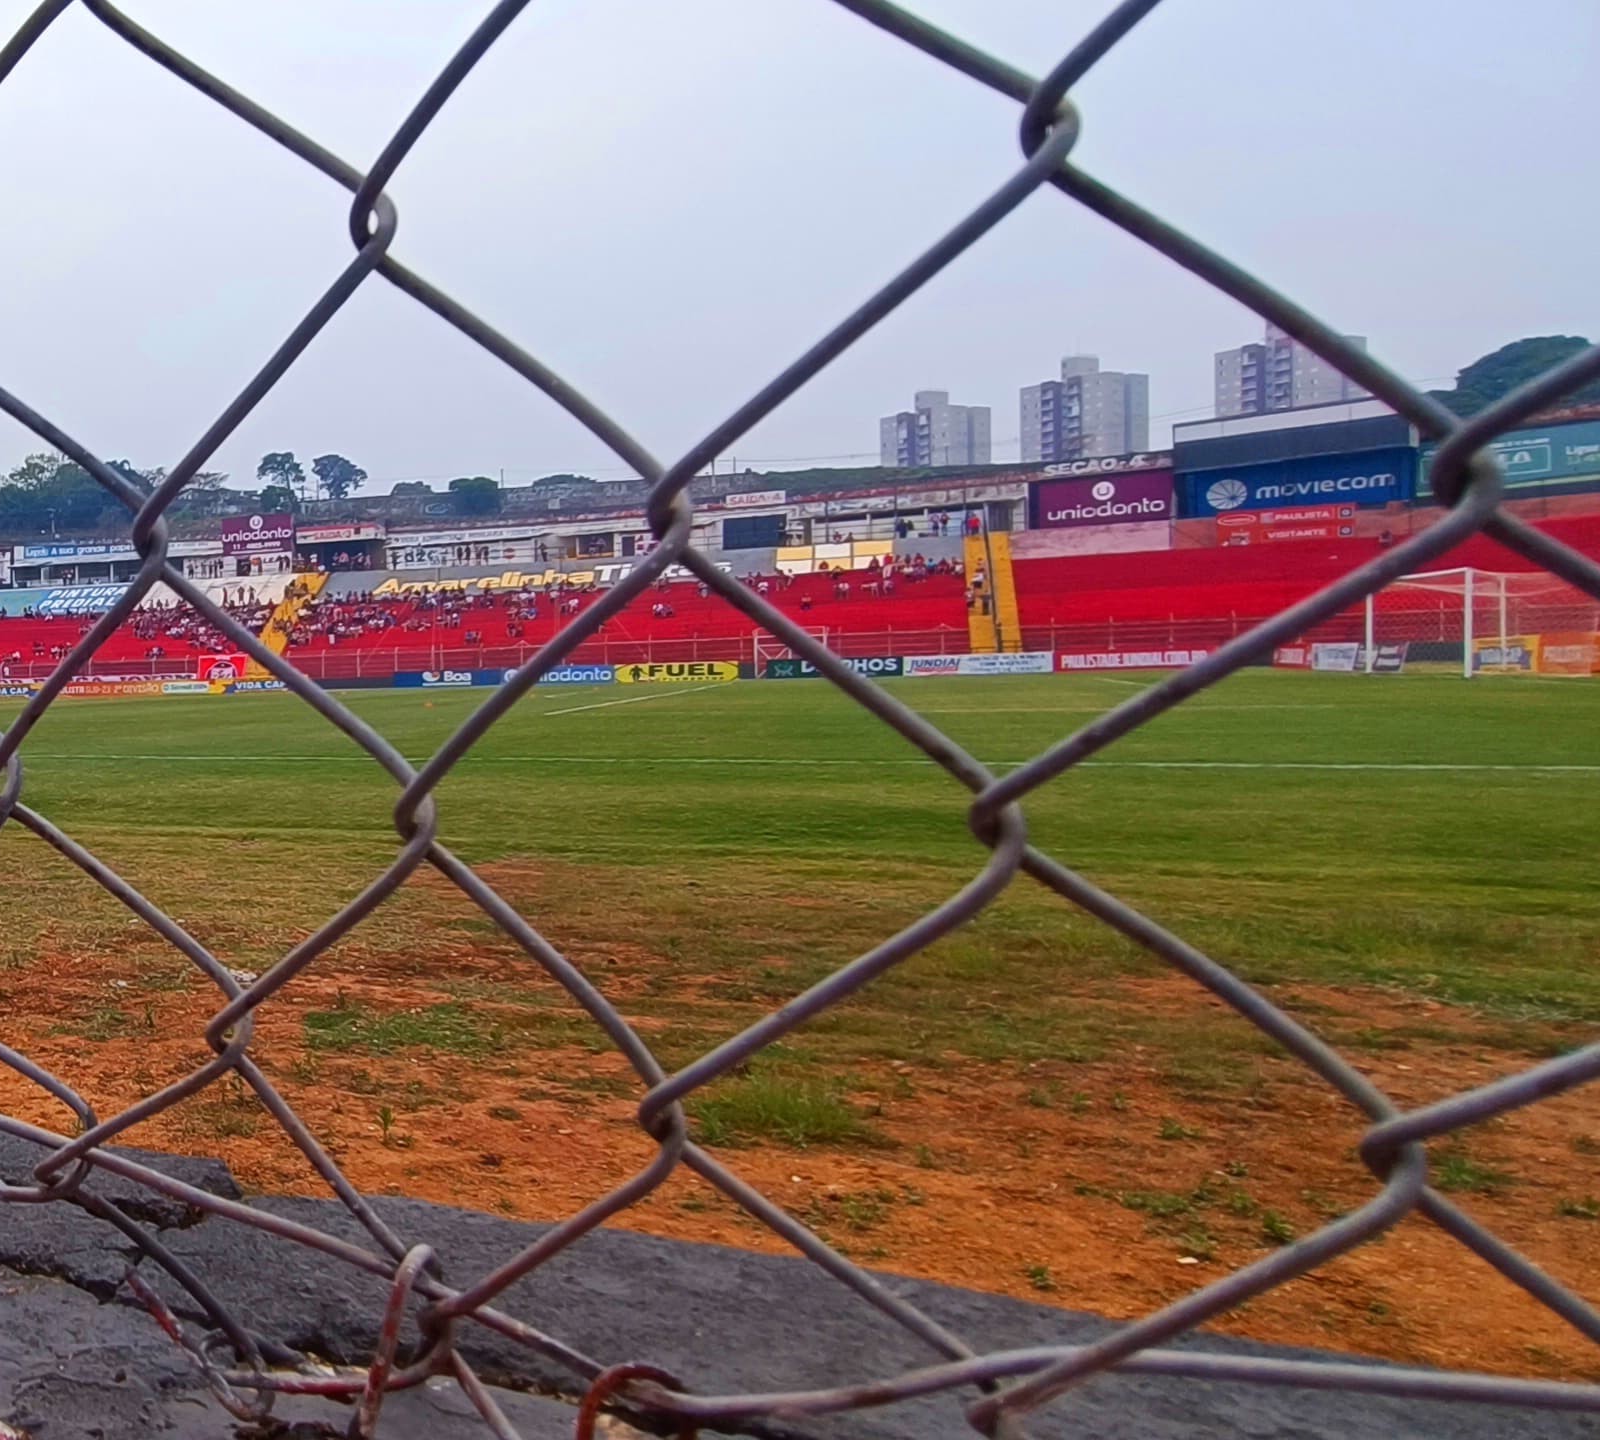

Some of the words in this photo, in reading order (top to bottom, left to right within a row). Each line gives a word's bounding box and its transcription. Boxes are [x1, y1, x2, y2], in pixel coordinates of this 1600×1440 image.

[1048, 498, 1165, 521] uniodonto
[222, 526, 292, 542] uniodonto
[1268, 528, 1327, 538] VISITANTE
[39, 597, 116, 609] PREDIAL
[539, 666, 612, 682] iodonto
[649, 663, 724, 677] FUEL
[444, 671, 472, 682] Boa
[9, 687, 28, 695] CAP
[236, 681, 262, 690] VIDA
